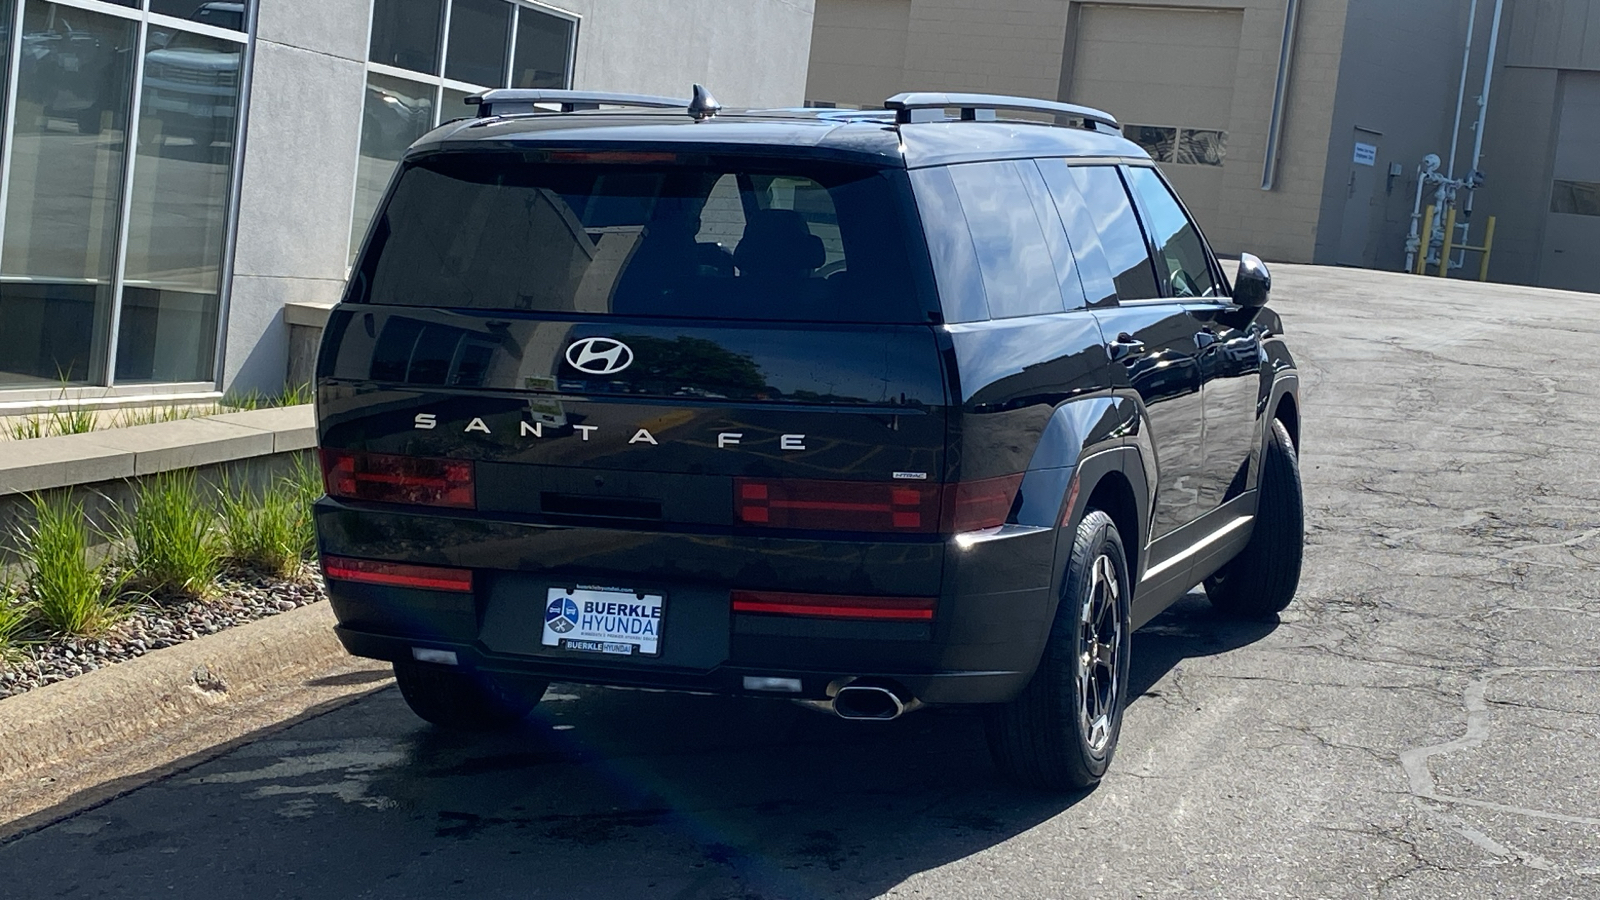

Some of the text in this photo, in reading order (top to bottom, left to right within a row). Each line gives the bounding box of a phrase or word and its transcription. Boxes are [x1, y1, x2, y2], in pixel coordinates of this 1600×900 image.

[414, 412, 806, 451] SANTA FE
[583, 601, 661, 618] BUERKLE
[567, 641, 630, 653] BUERKLE HYUNDAI
